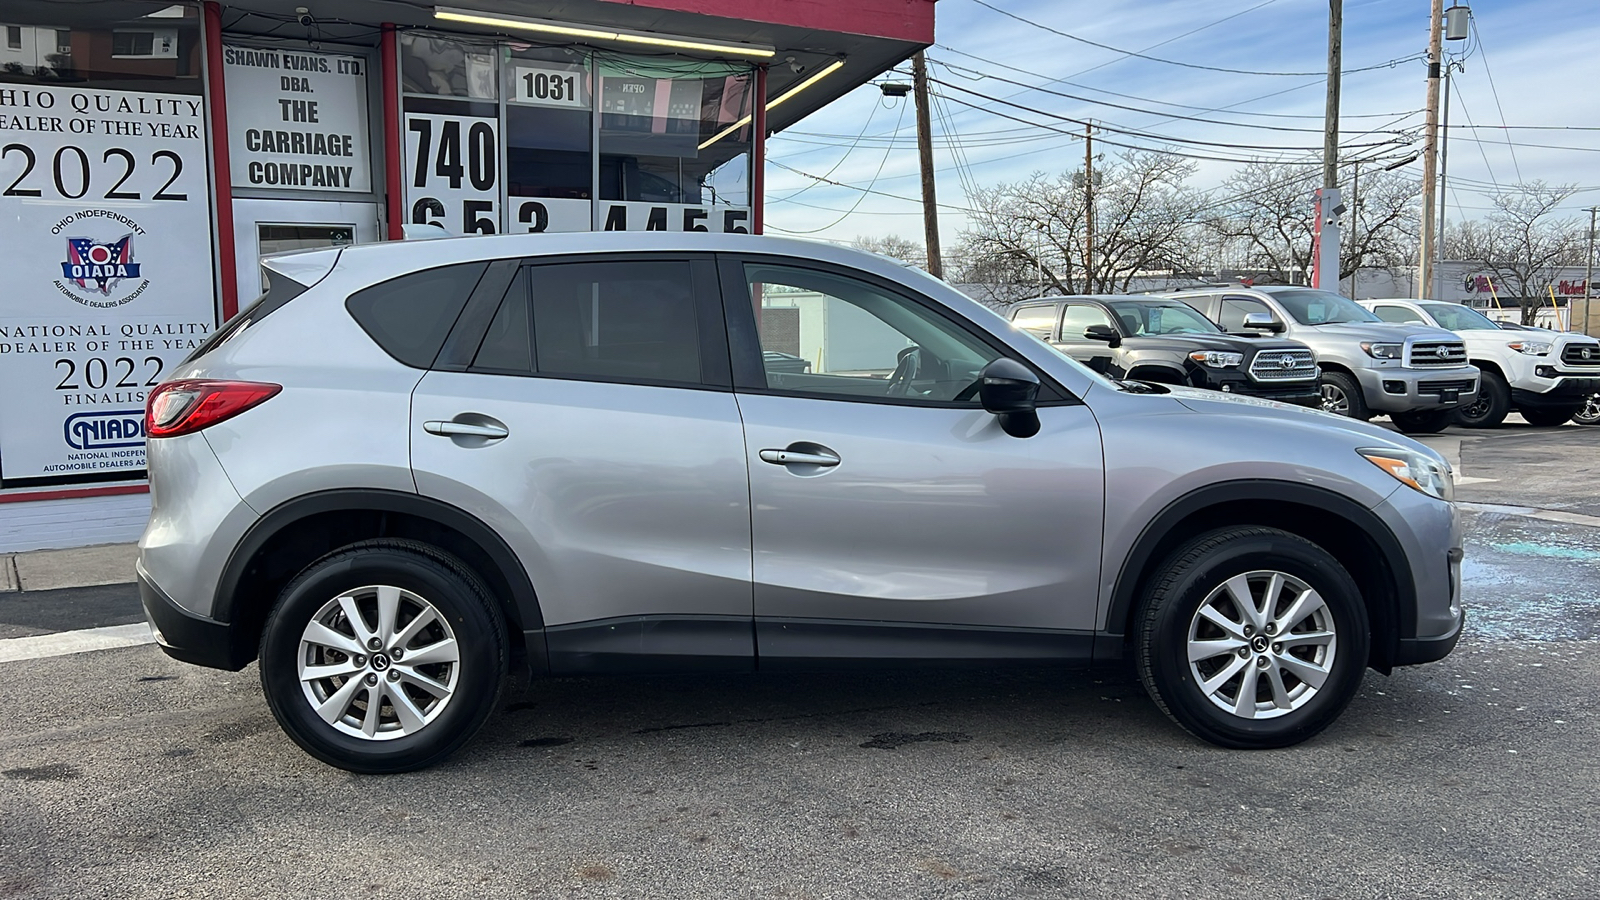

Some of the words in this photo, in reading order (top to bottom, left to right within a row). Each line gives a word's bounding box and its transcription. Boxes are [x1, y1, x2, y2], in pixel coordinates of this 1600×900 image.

[225, 50, 280, 69] SHAWN
[283, 54, 331, 73] EVANS.
[337, 59, 364, 76] LTD.
[280, 75, 314, 93] DBA.
[523, 73, 574, 100] 1031
[70, 93, 200, 117] QUALITY
[279, 98, 319, 123] THE
[69, 118, 96, 134] OF
[101, 120, 143, 136] THE
[147, 122, 200, 139] YEAR
[245, 128, 353, 157] CARRIAGE
[409, 117, 496, 192] 740
[2, 143, 189, 202] 2022
[248, 161, 353, 188] COMPANY
[51, 215, 74, 235] OHIO
[75, 209, 146, 236] INDEPENDENT
[71, 264, 127, 277] OIADA
[53, 279, 88, 305] AUTOMOBILE
[89, 300, 117, 309] DEALERS
[118, 279, 150, 306] ASSOCIATION
[0, 324, 110, 338] NATIONAL
[120, 323, 210, 337] QUALITY
[0, 341, 77, 354] DEALER
[86, 340, 109, 352] OF
[118, 339, 155, 351] THE
[54, 356, 164, 390] 2022
[63, 391, 149, 405] FINALIS
[43, 462, 97, 472] AUTOMOBILE
[99, 459, 134, 469] DEALERS
[67, 451, 109, 461] NATIONAL
